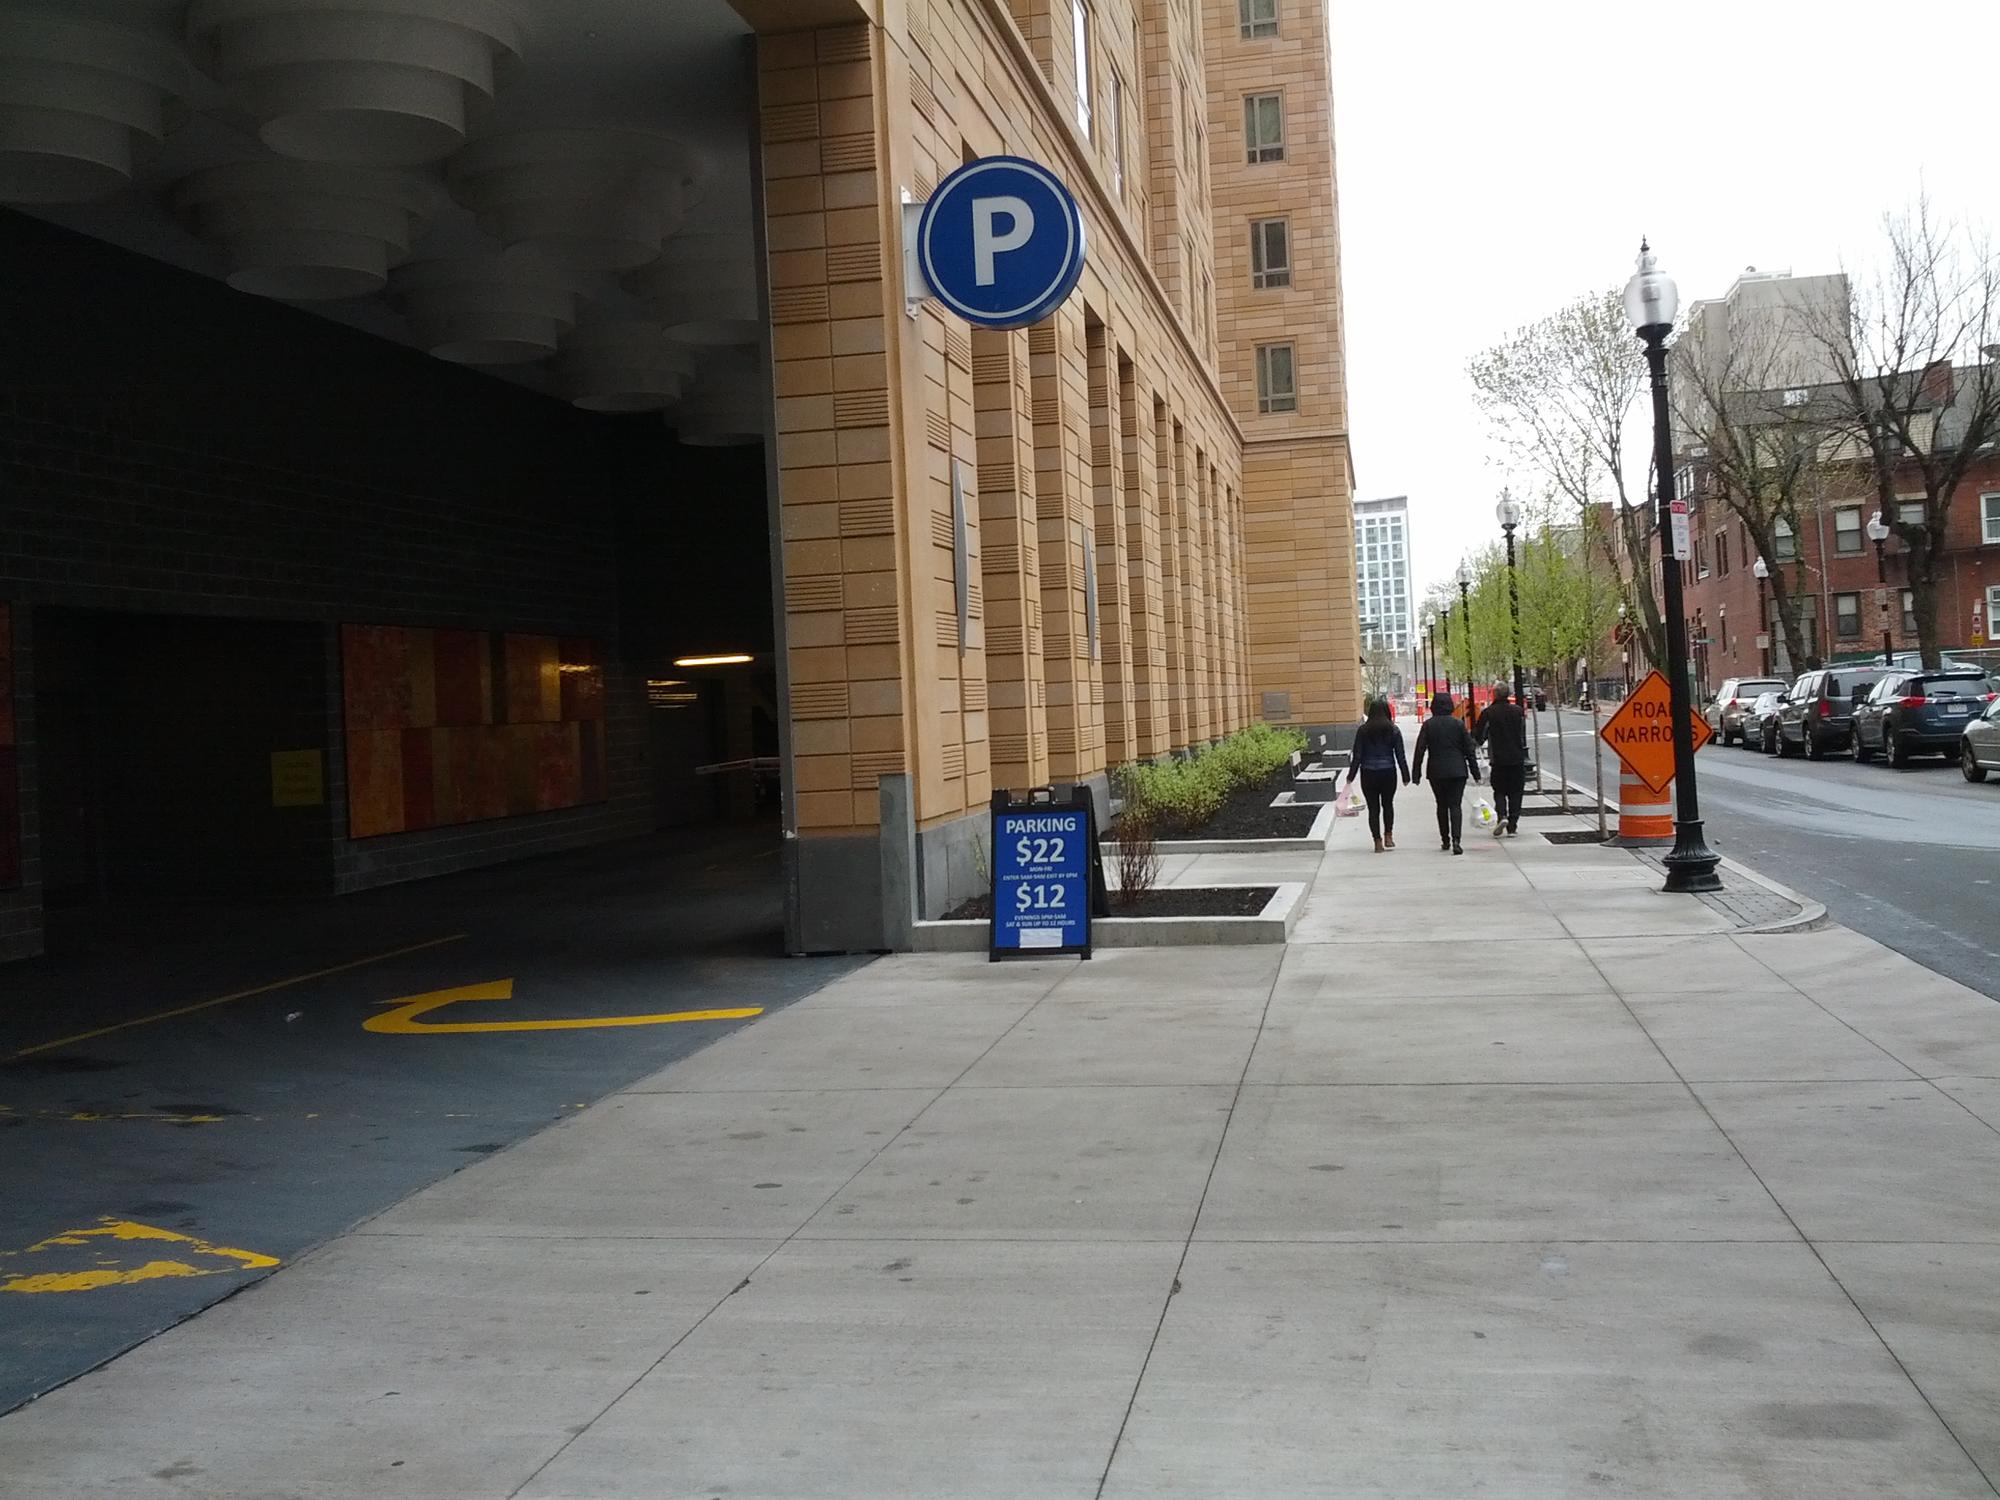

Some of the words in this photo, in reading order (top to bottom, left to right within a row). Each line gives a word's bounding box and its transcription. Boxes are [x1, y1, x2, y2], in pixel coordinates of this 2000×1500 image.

[972, 195, 1034, 287] P
[1614, 725, 1699, 743] NARROS
[1006, 817, 1076, 834] PARKING
[1016, 835, 1065, 867] $22
[1016, 882, 1066, 913] $12
